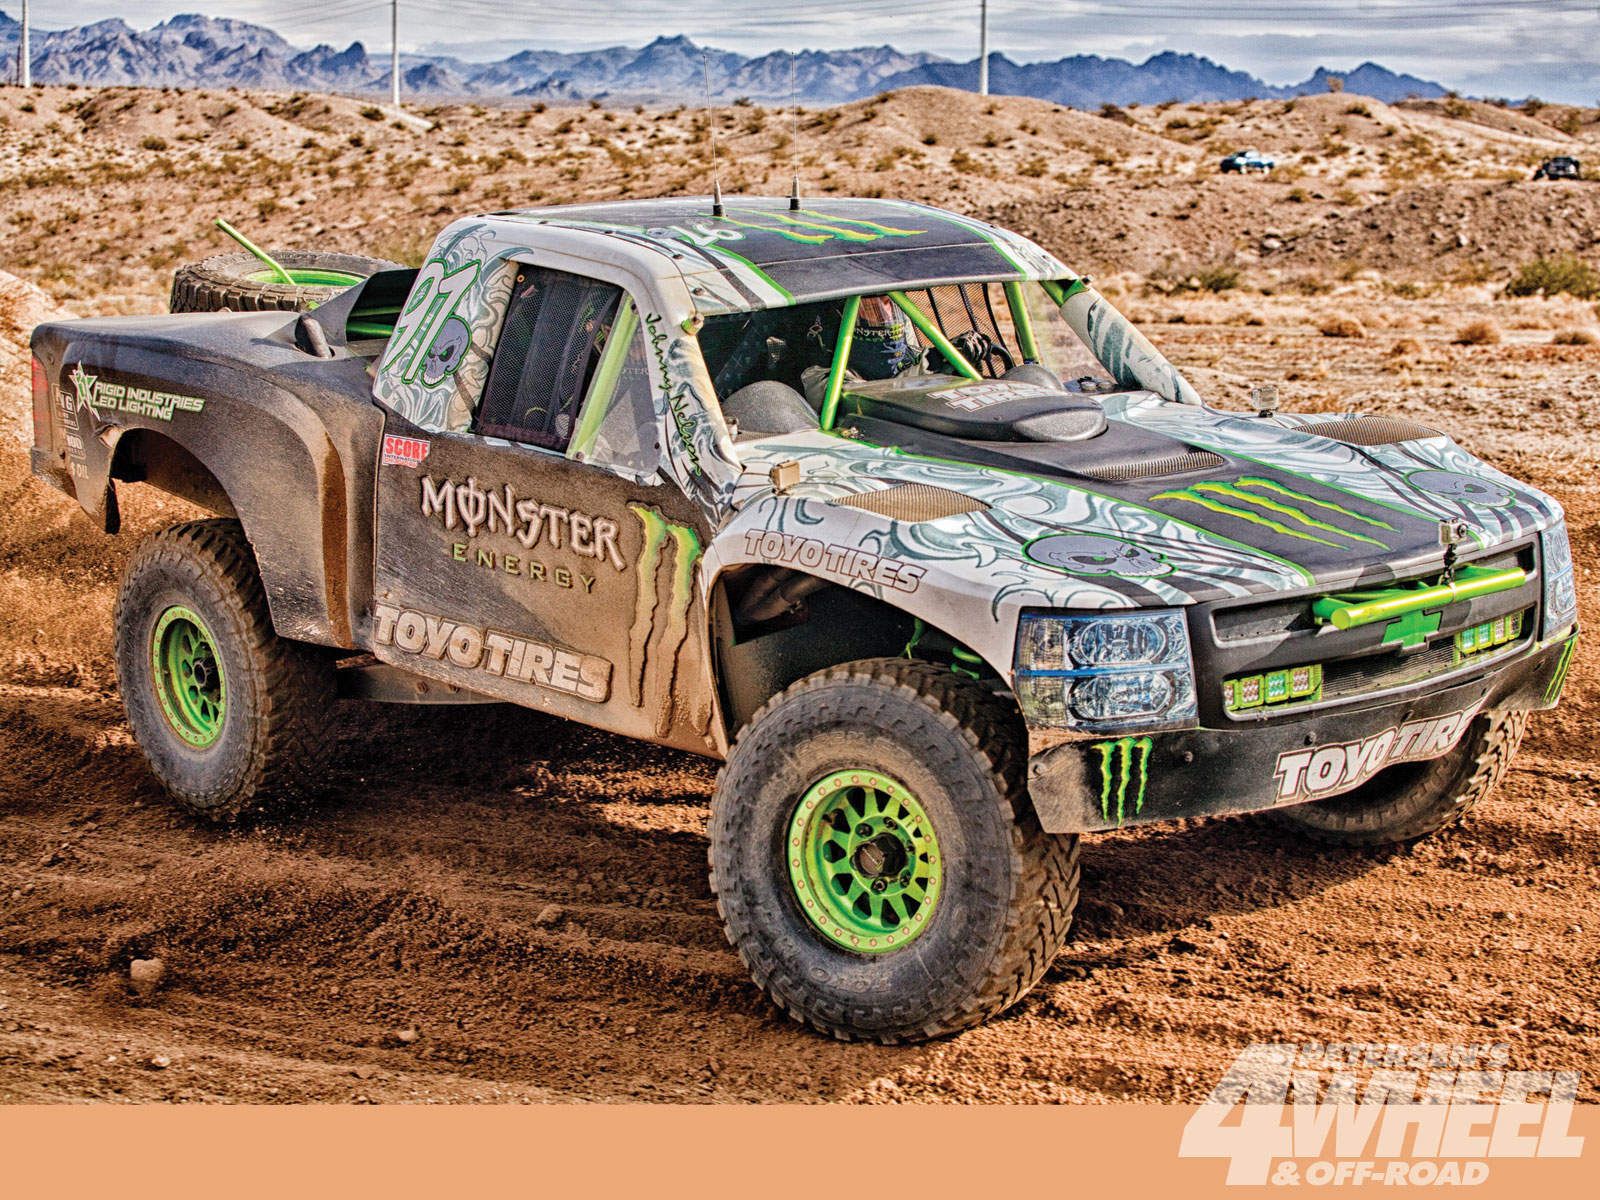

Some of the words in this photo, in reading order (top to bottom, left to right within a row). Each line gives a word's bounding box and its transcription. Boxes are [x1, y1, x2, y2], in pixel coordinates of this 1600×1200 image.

[92, 390, 117, 410] LED
[118, 399, 174, 421] LIGHTING
[94, 381, 126, 398] RIGID
[127, 386, 205, 412] INDUSTRIES
[421, 474, 627, 571] MONSTER
[452, 543, 596, 593] ENERGY
[373, 603, 486, 669] TOYO
[482, 630, 614, 703] TIRES
[1273, 727, 1398, 802] TOYO
